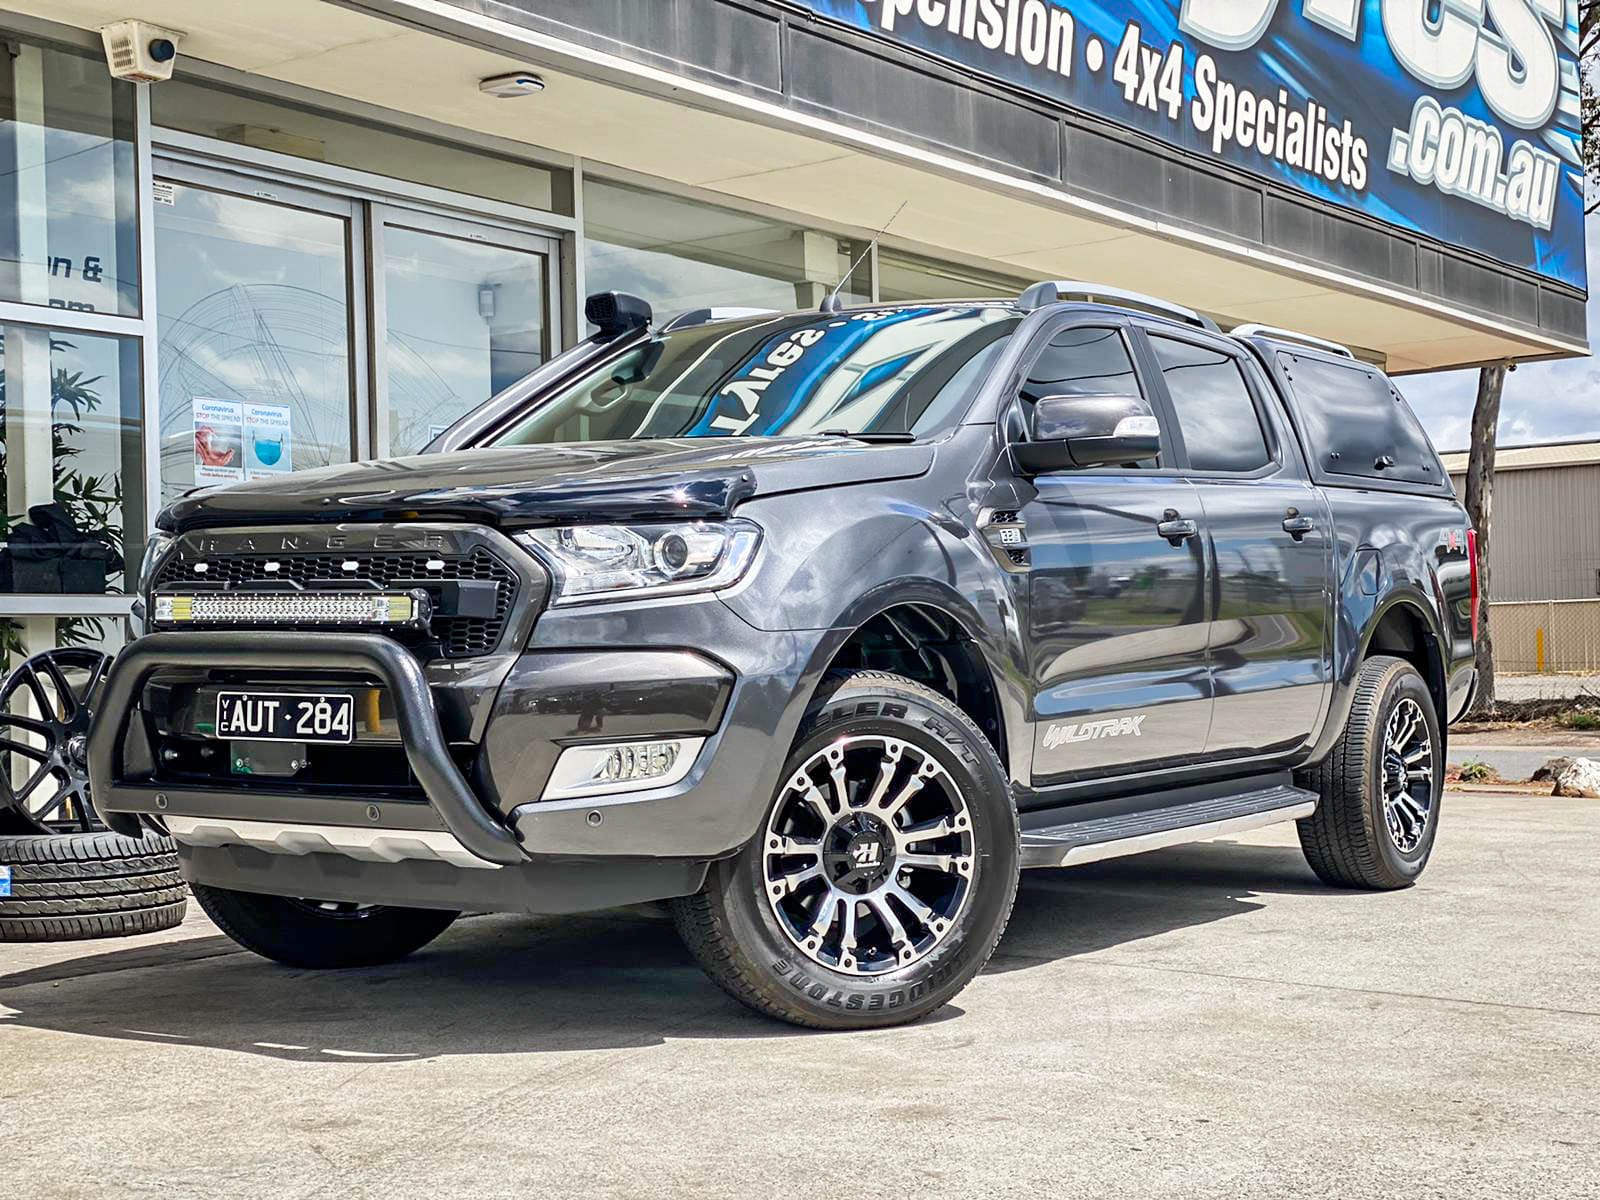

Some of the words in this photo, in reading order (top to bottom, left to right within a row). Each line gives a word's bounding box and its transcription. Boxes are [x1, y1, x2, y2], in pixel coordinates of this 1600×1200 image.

[1113, 23, 1184, 120] 4x4
[1191, 54, 1368, 190] Specialists
[1388, 97, 1560, 230] .com.au
[202, 404, 234, 413] Coronavirus
[251, 408, 282, 417] Coronavirus
[199, 532, 443, 551] RANGER
[230, 699, 280, 733] AUT
[296, 701, 349, 735] 284
[1043, 714, 1146, 750] WILDTRAK
